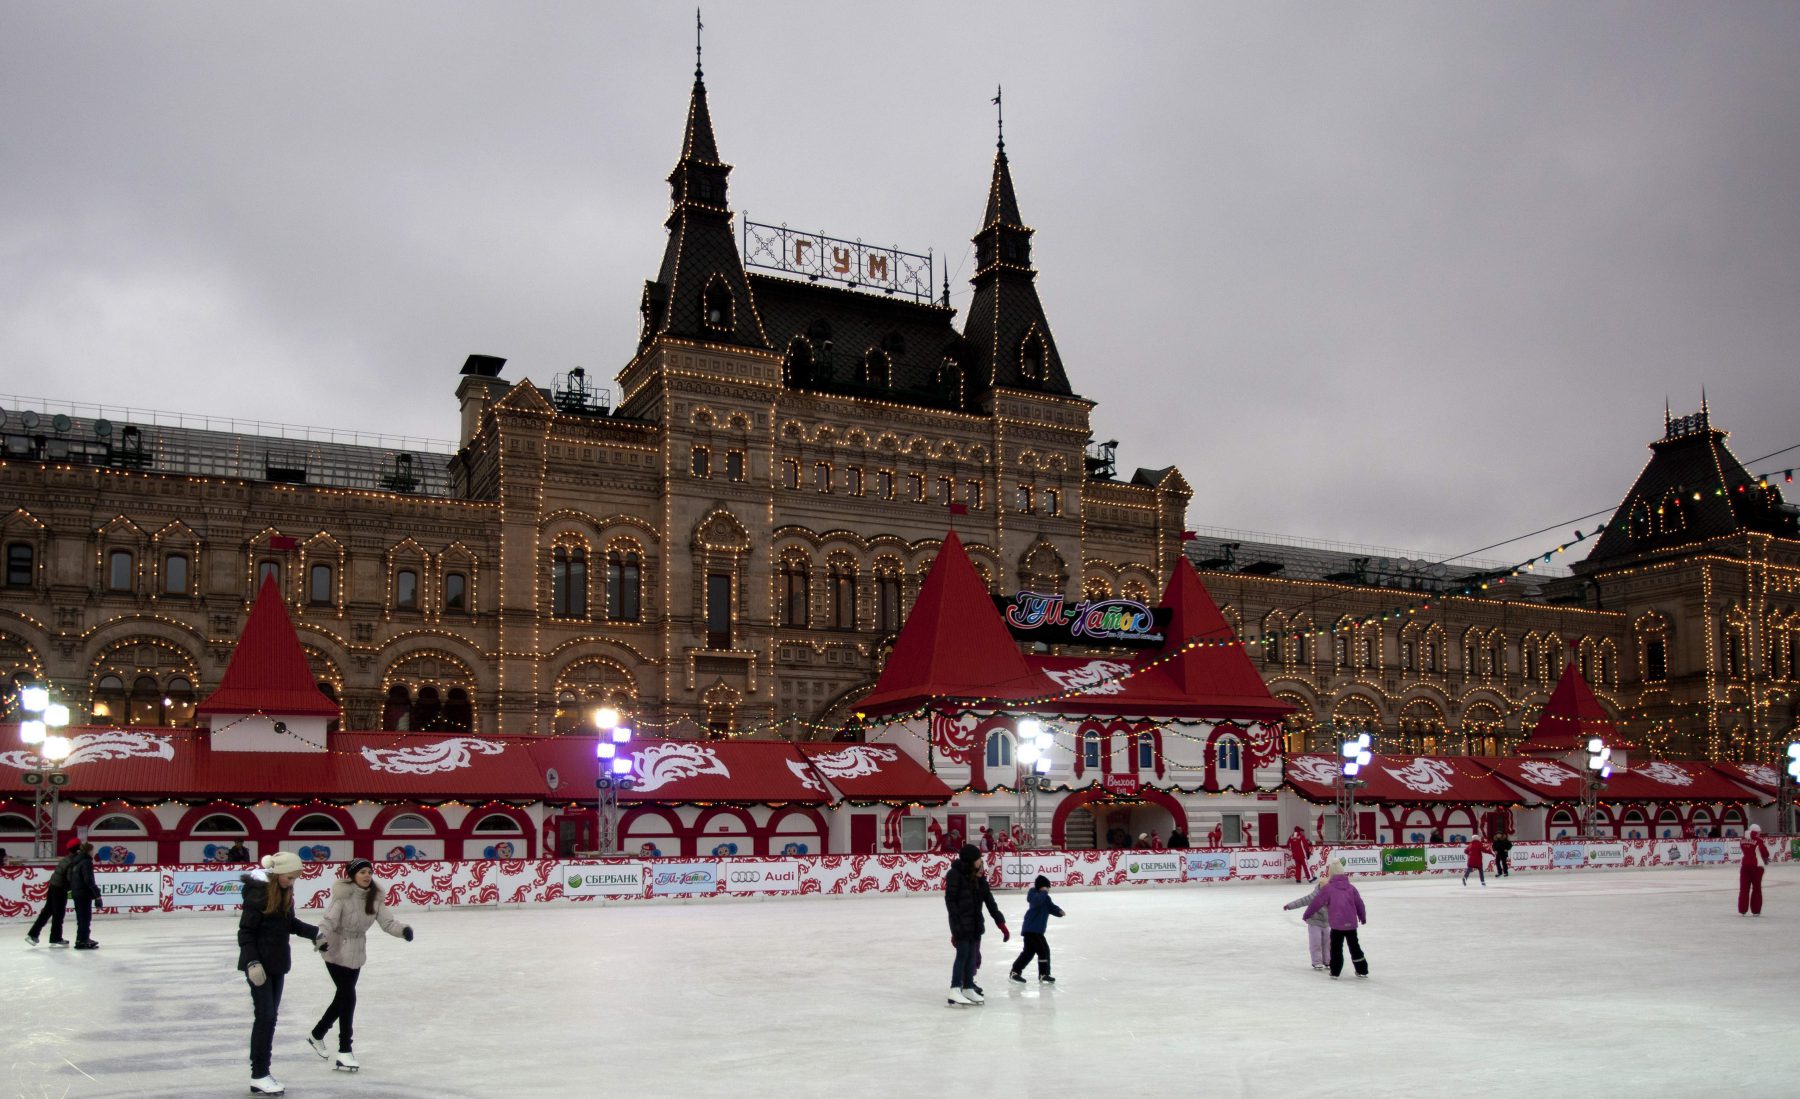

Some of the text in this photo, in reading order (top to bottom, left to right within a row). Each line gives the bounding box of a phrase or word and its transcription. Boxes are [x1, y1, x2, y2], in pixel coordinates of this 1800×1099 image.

[795, 239, 887, 281] ГУМ
[1141, 862, 1177, 870] СБЕРБАНК
[1261, 859, 1282, 867] Audi
[1038, 865, 1062, 873] Audi
[585, 874, 638, 884] СБЕРБАНК
[765, 872, 795, 881] Audi
